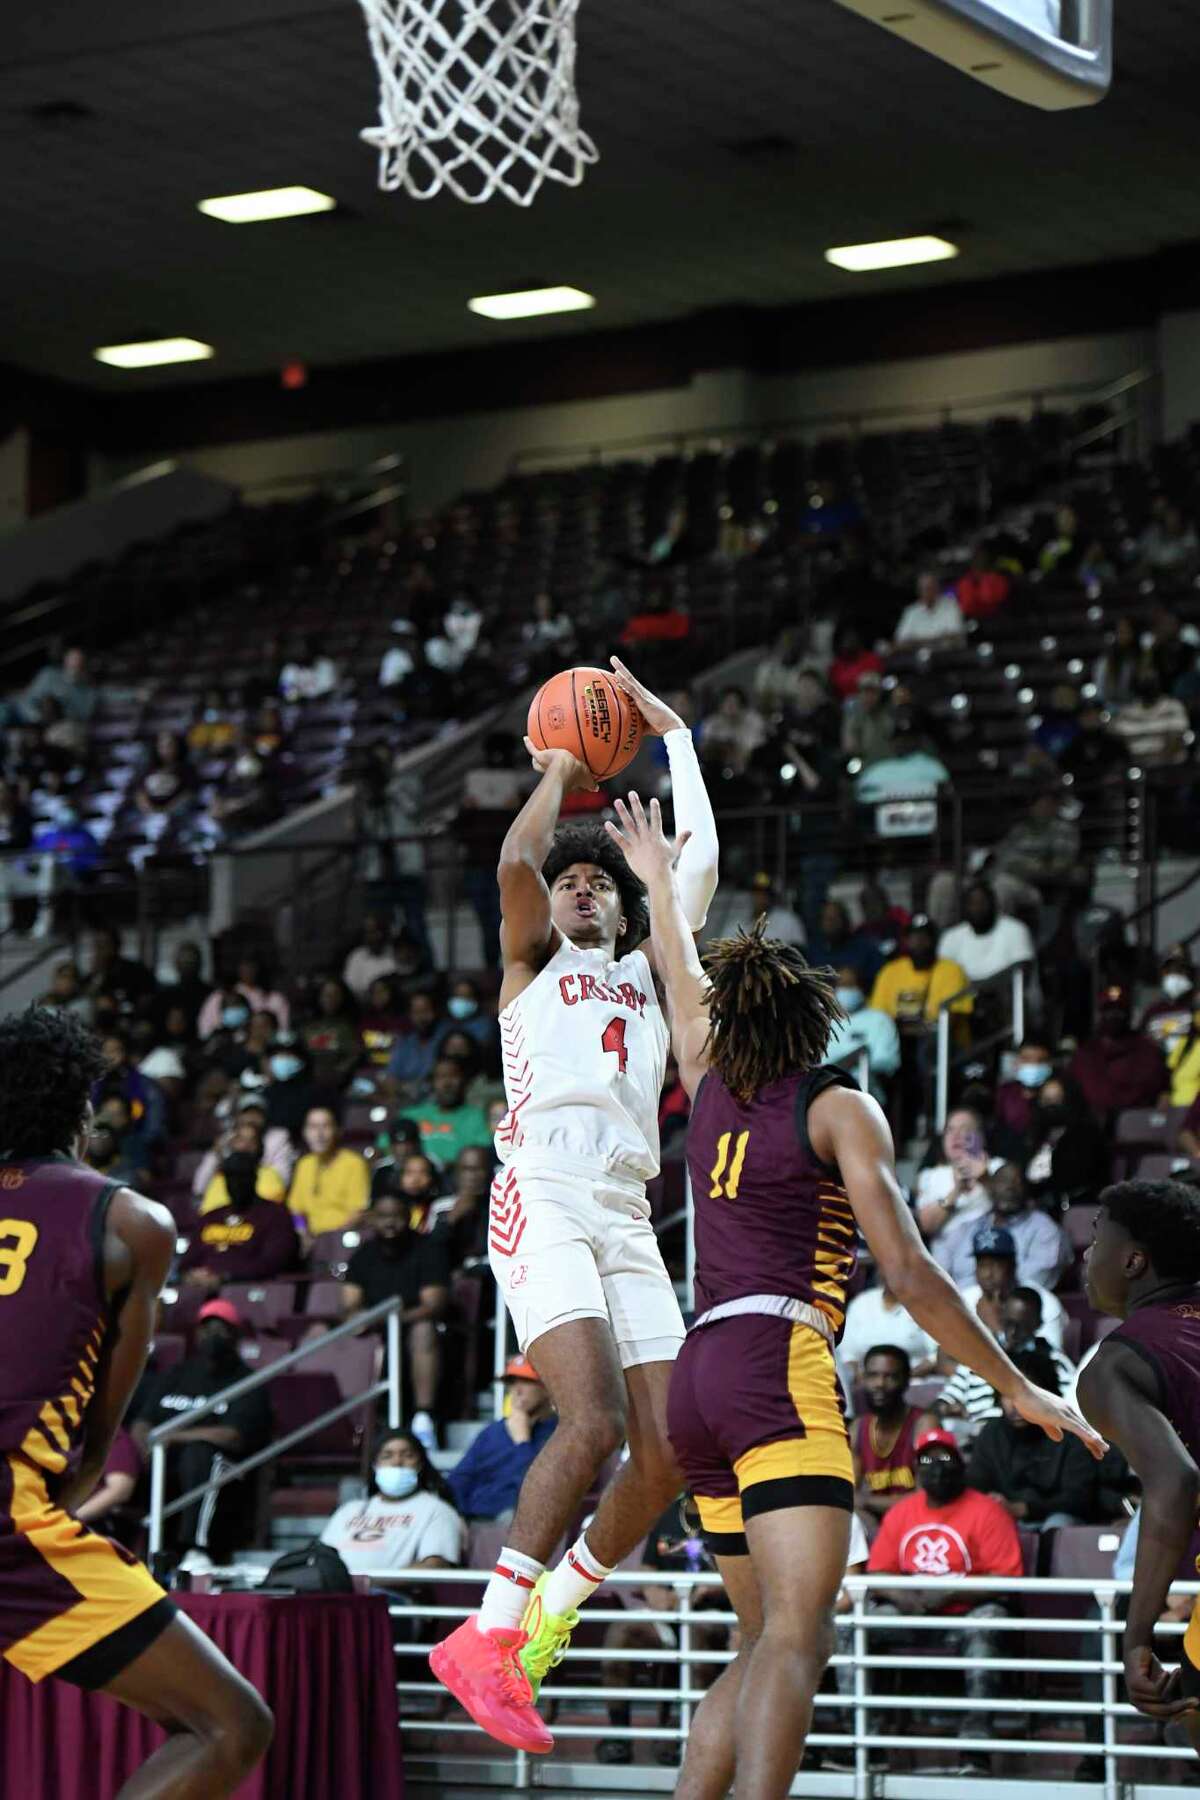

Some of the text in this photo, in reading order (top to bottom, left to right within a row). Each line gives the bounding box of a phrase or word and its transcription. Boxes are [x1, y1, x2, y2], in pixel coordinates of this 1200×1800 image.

[592, 680, 611, 743] LEGACY
[559, 973, 647, 1019] CROSBY
[601, 1016, 628, 1074] 4
[708, 1130, 750, 1200] 11
